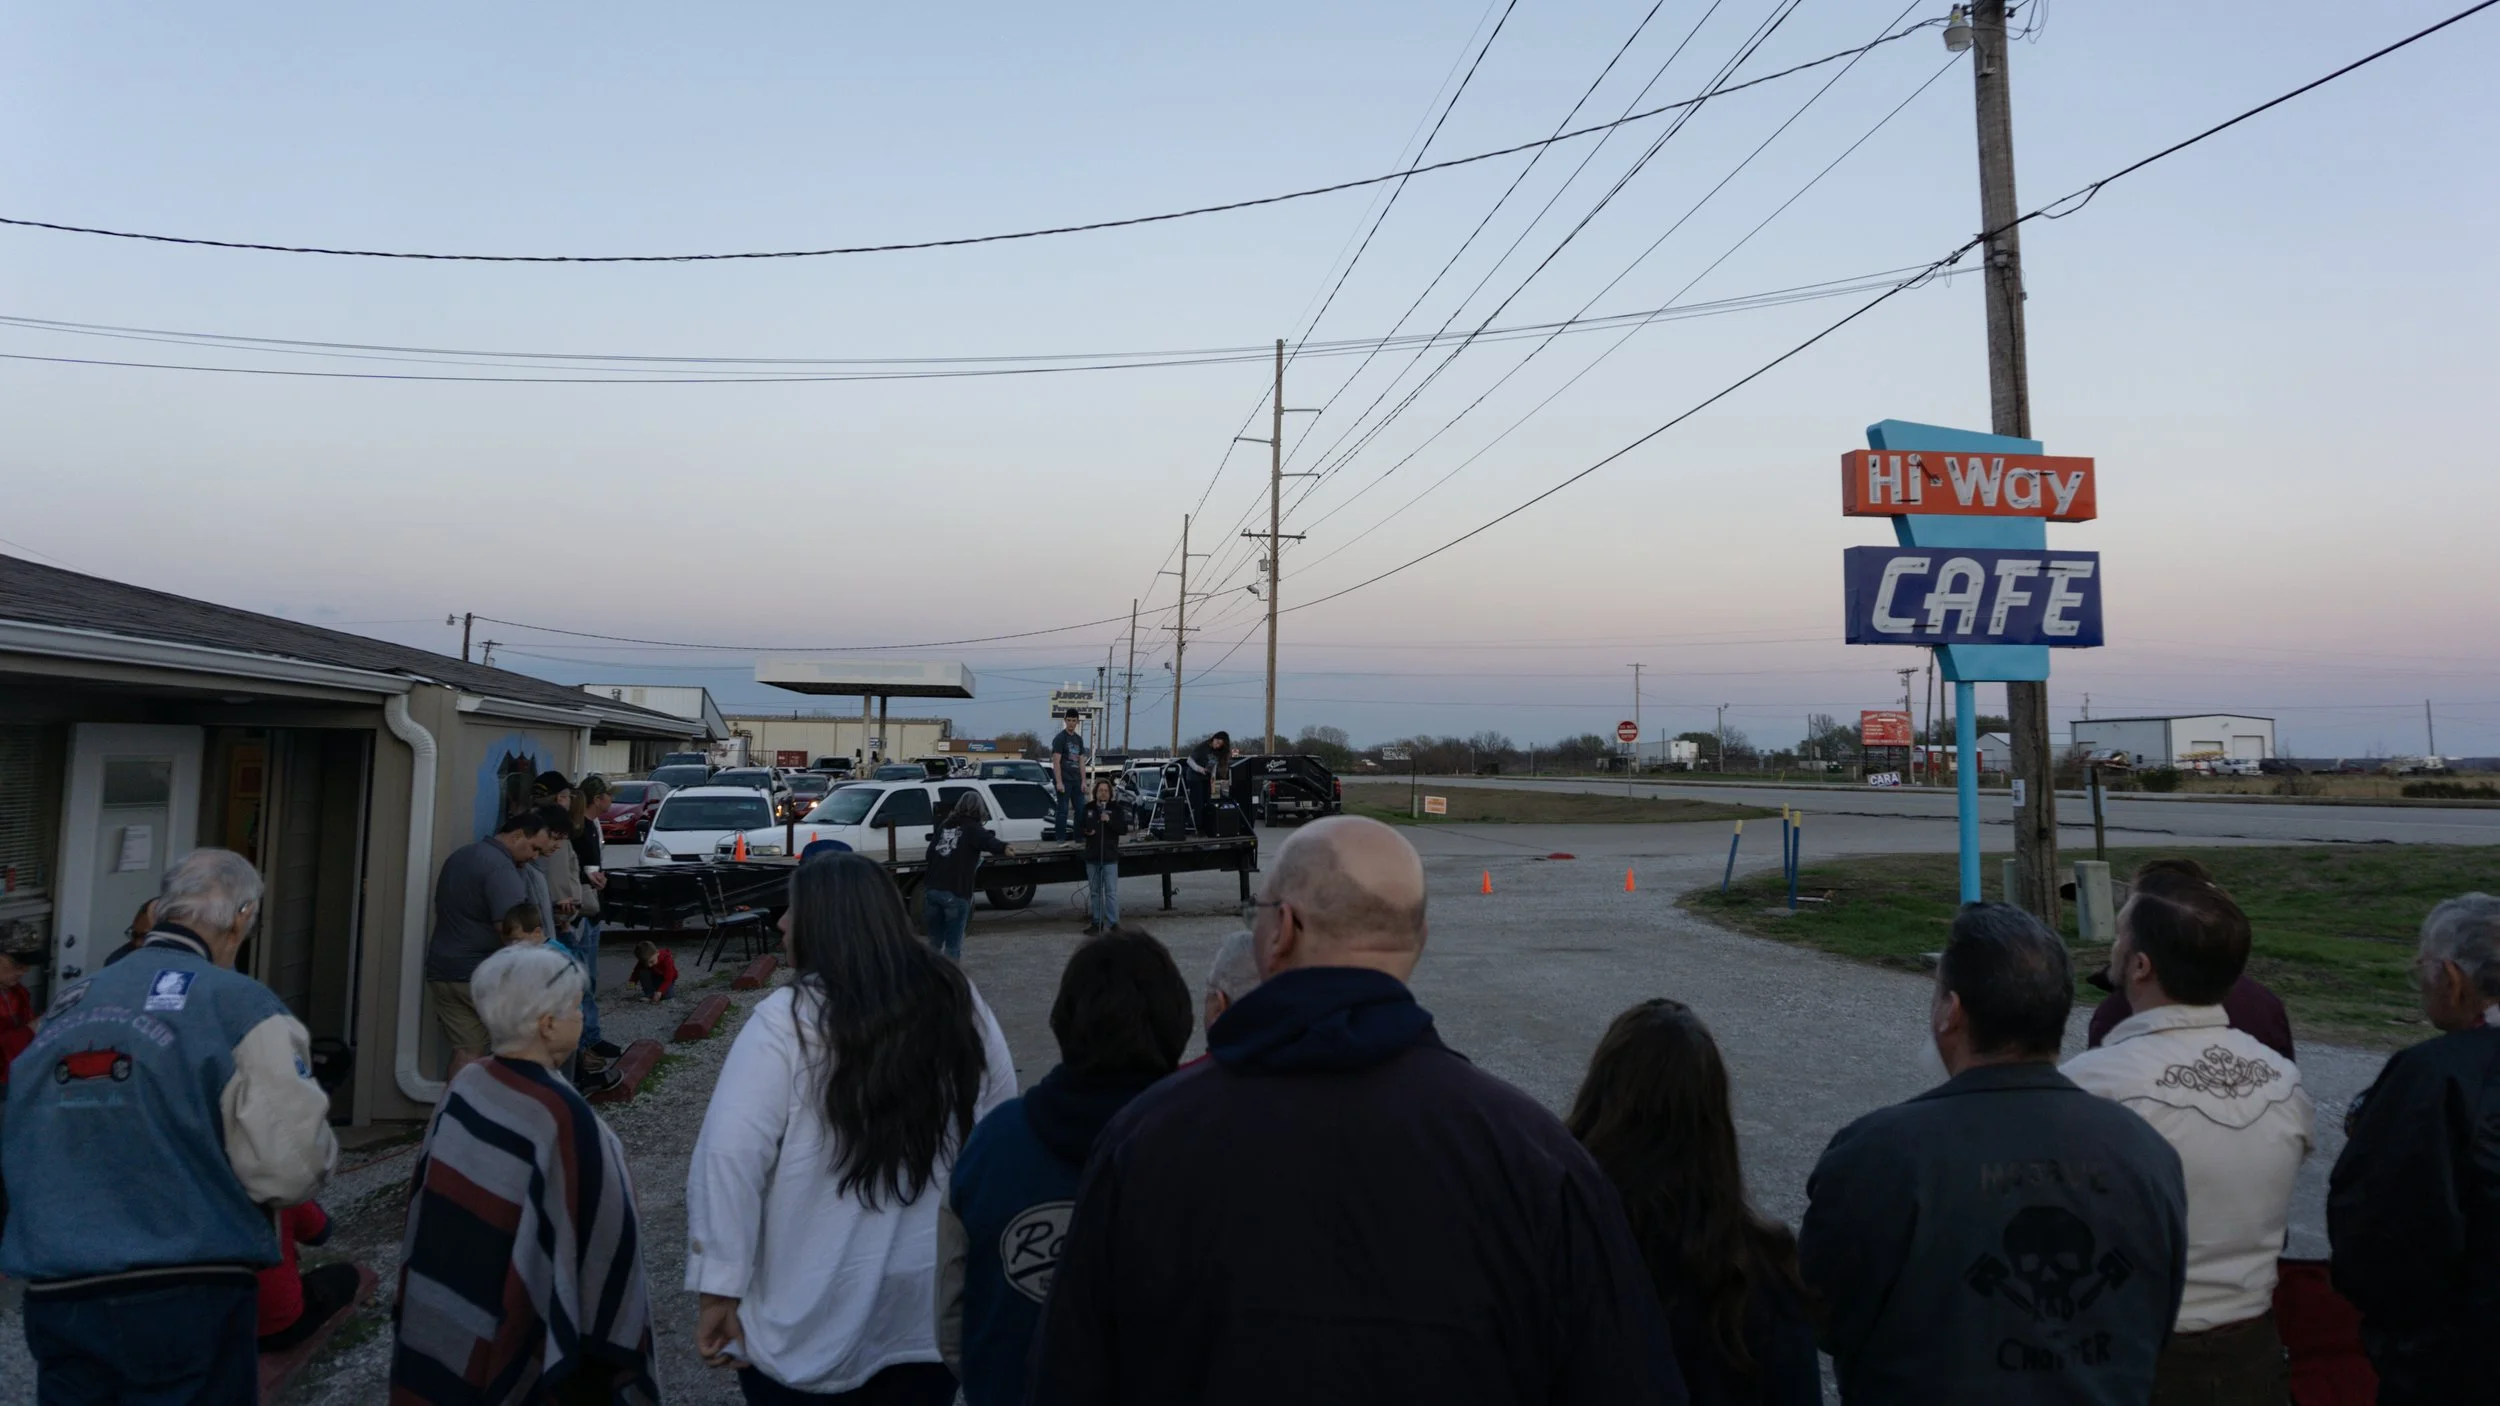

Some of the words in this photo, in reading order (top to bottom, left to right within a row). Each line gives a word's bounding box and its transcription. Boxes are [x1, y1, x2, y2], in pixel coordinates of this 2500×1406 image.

[1868, 454, 2085, 514] Hi-Way
[1872, 556, 2095, 637] CAFE
[1870, 773, 1899, 785] CARA
[132, 1014, 176, 1047] CLUB
